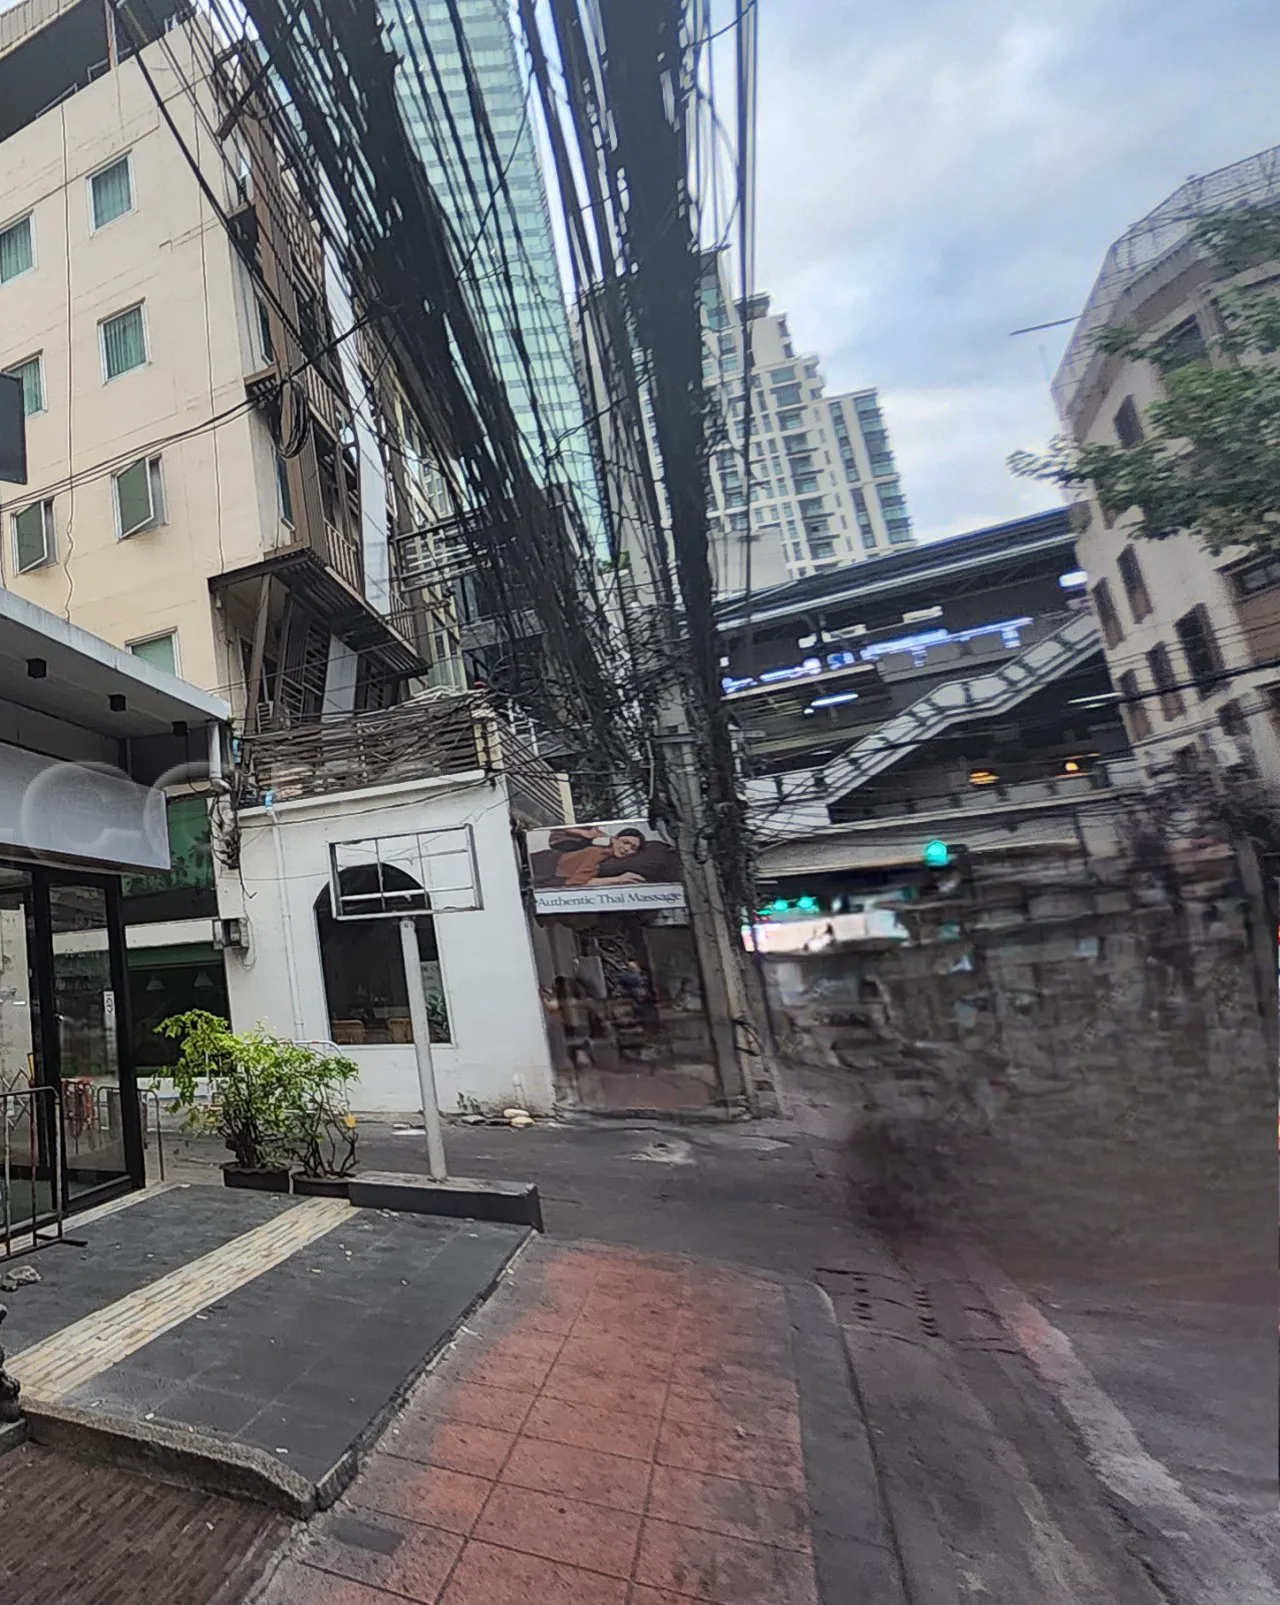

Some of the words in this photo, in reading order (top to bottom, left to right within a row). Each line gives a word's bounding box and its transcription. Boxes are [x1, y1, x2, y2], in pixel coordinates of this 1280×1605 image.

[538, 894, 595, 908] Authentic
[597, 893, 625, 905] Thai
[627, 891, 682, 904] Massage
